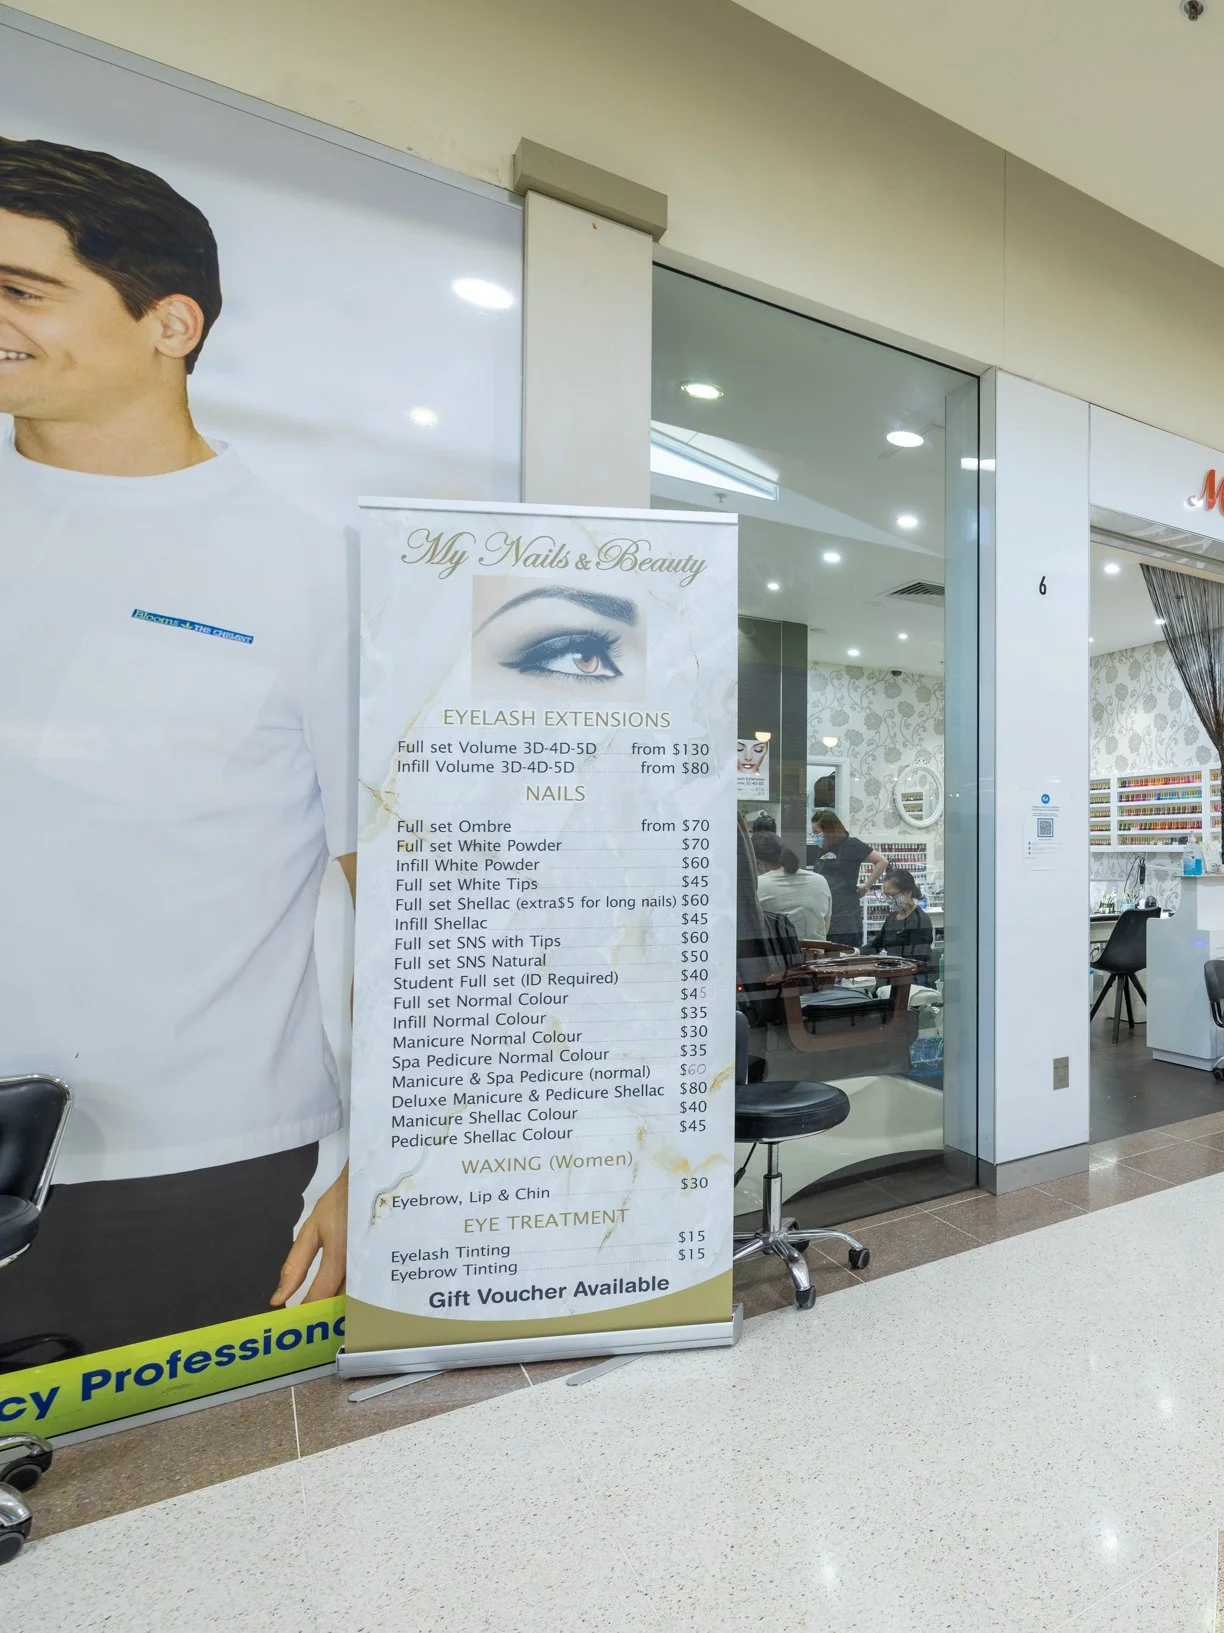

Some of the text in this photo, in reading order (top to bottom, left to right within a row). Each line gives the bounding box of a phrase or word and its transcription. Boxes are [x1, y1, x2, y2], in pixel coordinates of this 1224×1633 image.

[401, 529, 707, 587] My Nails & Beauty
[1039, 576, 1047, 595] 6
[444, 709, 671, 727] EYELASH EXTENSIONS
[398, 741, 709, 756] Full set Volume 3D-4D-5D from $130
[397, 760, 709, 775] Infill Volume 3D-4D-5D from $80
[526, 786, 585, 802] NAILS
[397, 819, 710, 833] Full set Ombre from $70
[397, 837, 710, 853] Full set White Powder $70
[396, 856, 709, 872] Infill White Powder $60
[396, 875, 708, 894] Full set White Tips $45
[395, 894, 709, 912] Full set Shellac (extra$5 for long nails) $60
[395, 912, 708, 931] Infill Shellac $45
[394, 931, 709, 950] Full set SNS with Tips $60
[394, 950, 708, 970] Full set SNS Natural $50
[393, 968, 708, 990] Student Full set (ID Required) $40
[393, 997, 420, 1010] Full
[427, 998, 450, 1009] set
[456, 995, 512, 1008] Normal
[518, 992, 568, 1006] Colour
[393, 1006, 707, 1029] Infill Normal Colour $35
[393, 1025, 708, 1049] Manicure Normal Colour $30
[392, 1043, 707, 1071] Spa Pedicure Normal Colour $35
[392, 1074, 464, 1089] Manicure
[470, 1073, 481, 1085] &
[486, 1071, 514, 1087] Spa
[520, 1068, 584, 1083] Pedicure
[589, 1066, 650, 1080] (normal)
[392, 1081, 707, 1109] Deluxe Manicure & Pedicure Shellac $80
[392, 1100, 707, 1128] Manicure Shellac Colour $40
[391, 1120, 706, 1148] Pedicure Shellac Colour $45
[461, 1152, 633, 1175] WAXING (Women)
[392, 1177, 708, 1209] Eyebrow, Lip & Chin $30
[464, 1208, 630, 1233] EYE TREATMENT
[391, 1230, 705, 1264] Eyelash Tinting $15
[391, 1248, 705, 1282] Eyebrow Tinting $15
[429, 1275, 669, 1308] Gift Voucher Available
